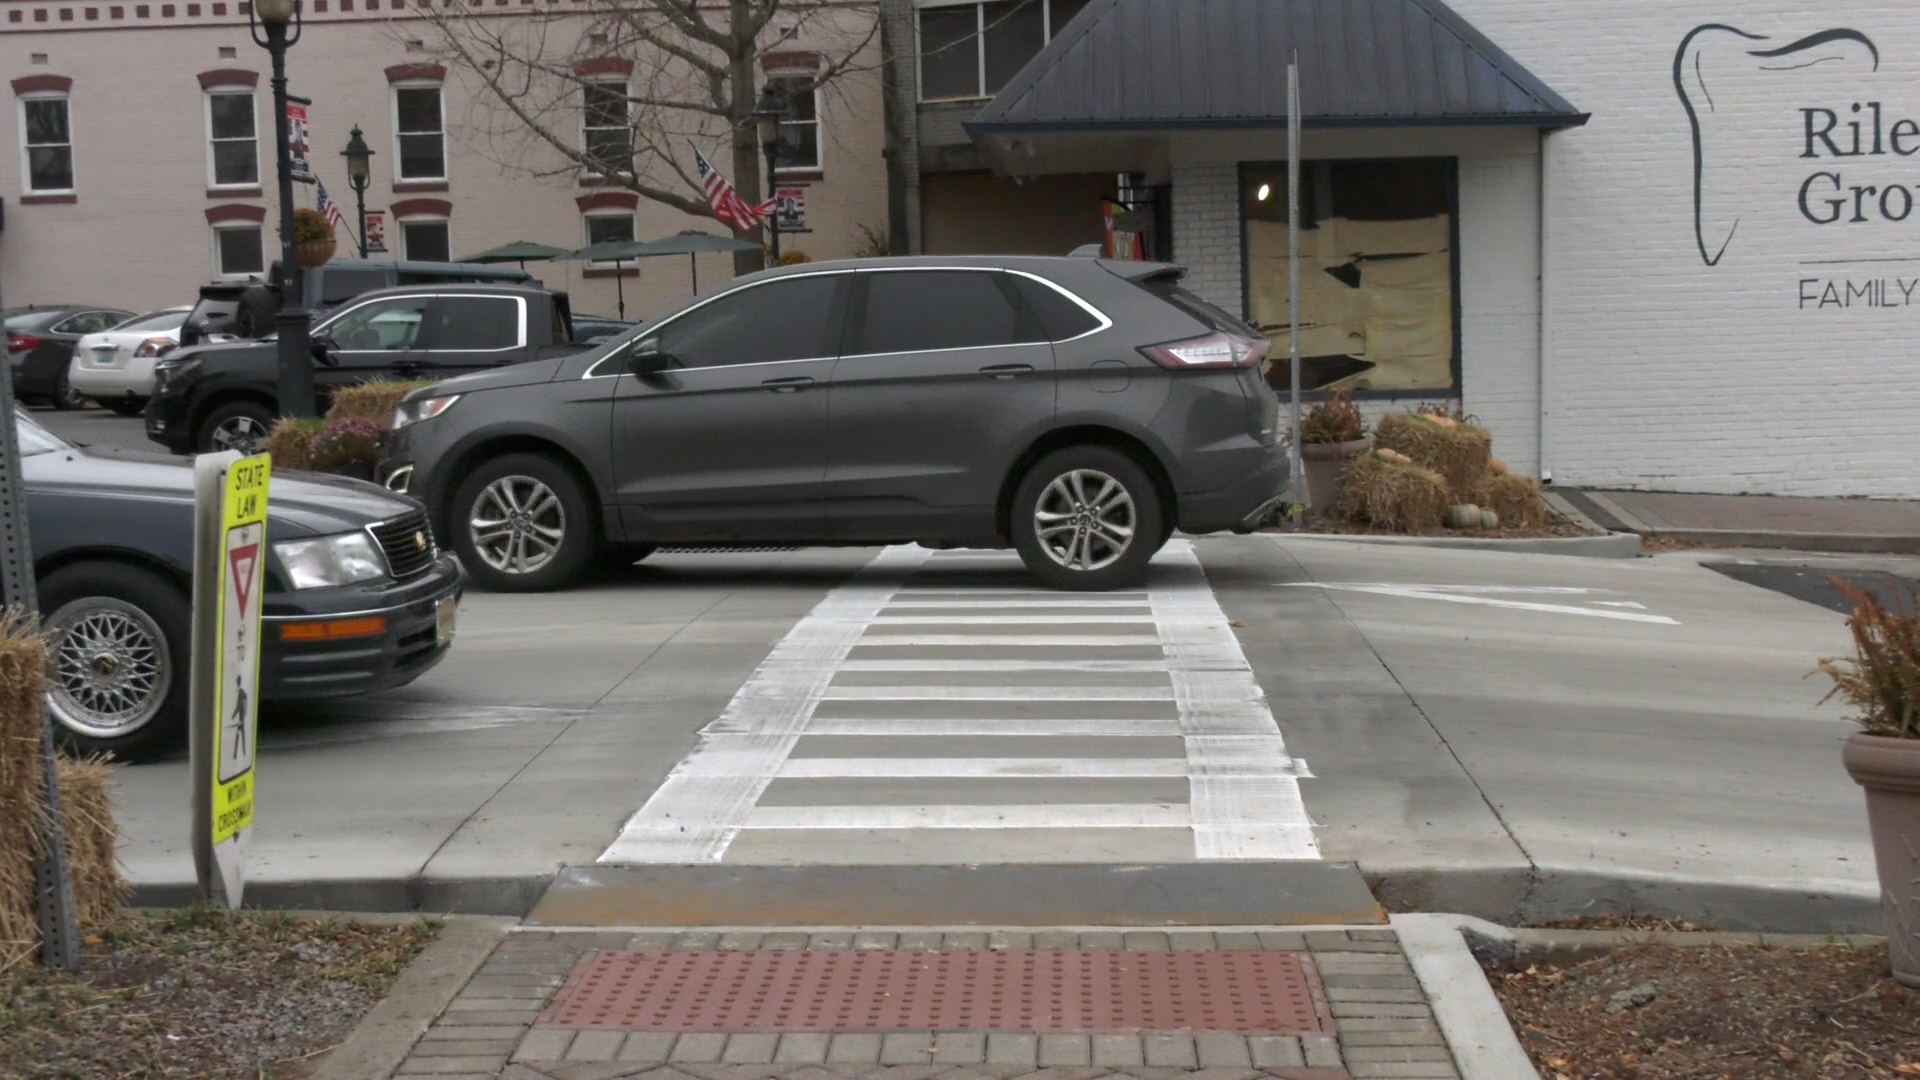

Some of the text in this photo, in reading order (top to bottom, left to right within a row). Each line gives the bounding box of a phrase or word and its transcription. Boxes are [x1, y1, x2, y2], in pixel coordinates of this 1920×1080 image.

[1799, 102, 1920, 158] Rile
[1798, 171, 1920, 225] Gro
[1799, 278, 1919, 309] FAMILY
[235, 464, 264, 491] STATE
[237, 494, 258, 519] LAW
